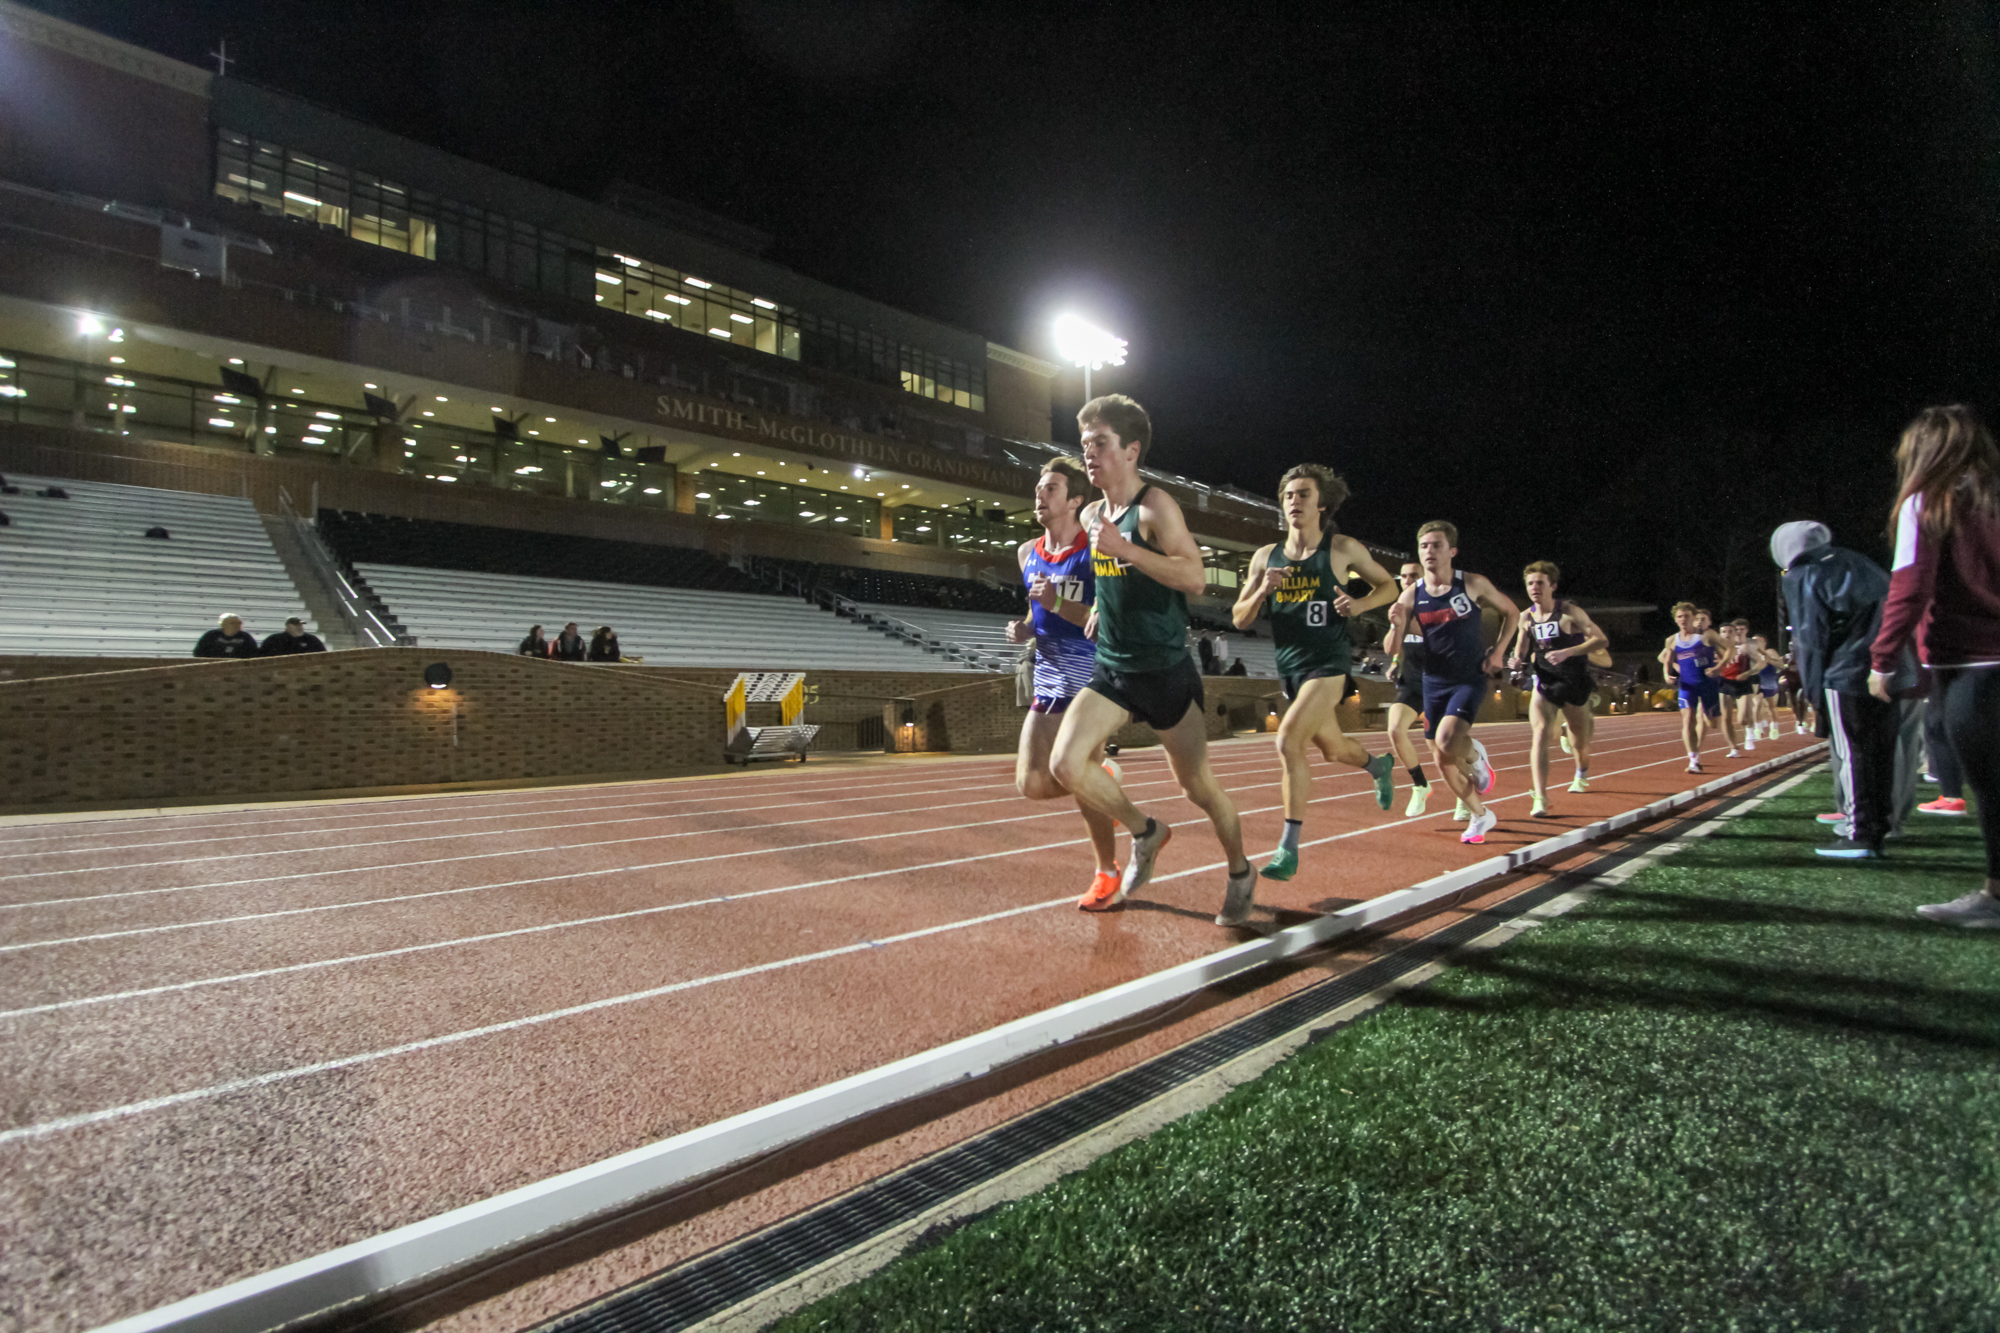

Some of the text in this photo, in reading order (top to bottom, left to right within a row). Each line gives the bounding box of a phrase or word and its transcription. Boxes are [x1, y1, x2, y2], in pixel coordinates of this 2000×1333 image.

[906, 450, 1023, 490] GRANDSTAND
[1059, 580, 1080, 600] 17
[1274, 577, 1320, 590] ILLIAM
[1309, 602, 1324, 625] 8
[1453, 596, 1469, 614] 3
[1537, 623, 1558, 638] 12
